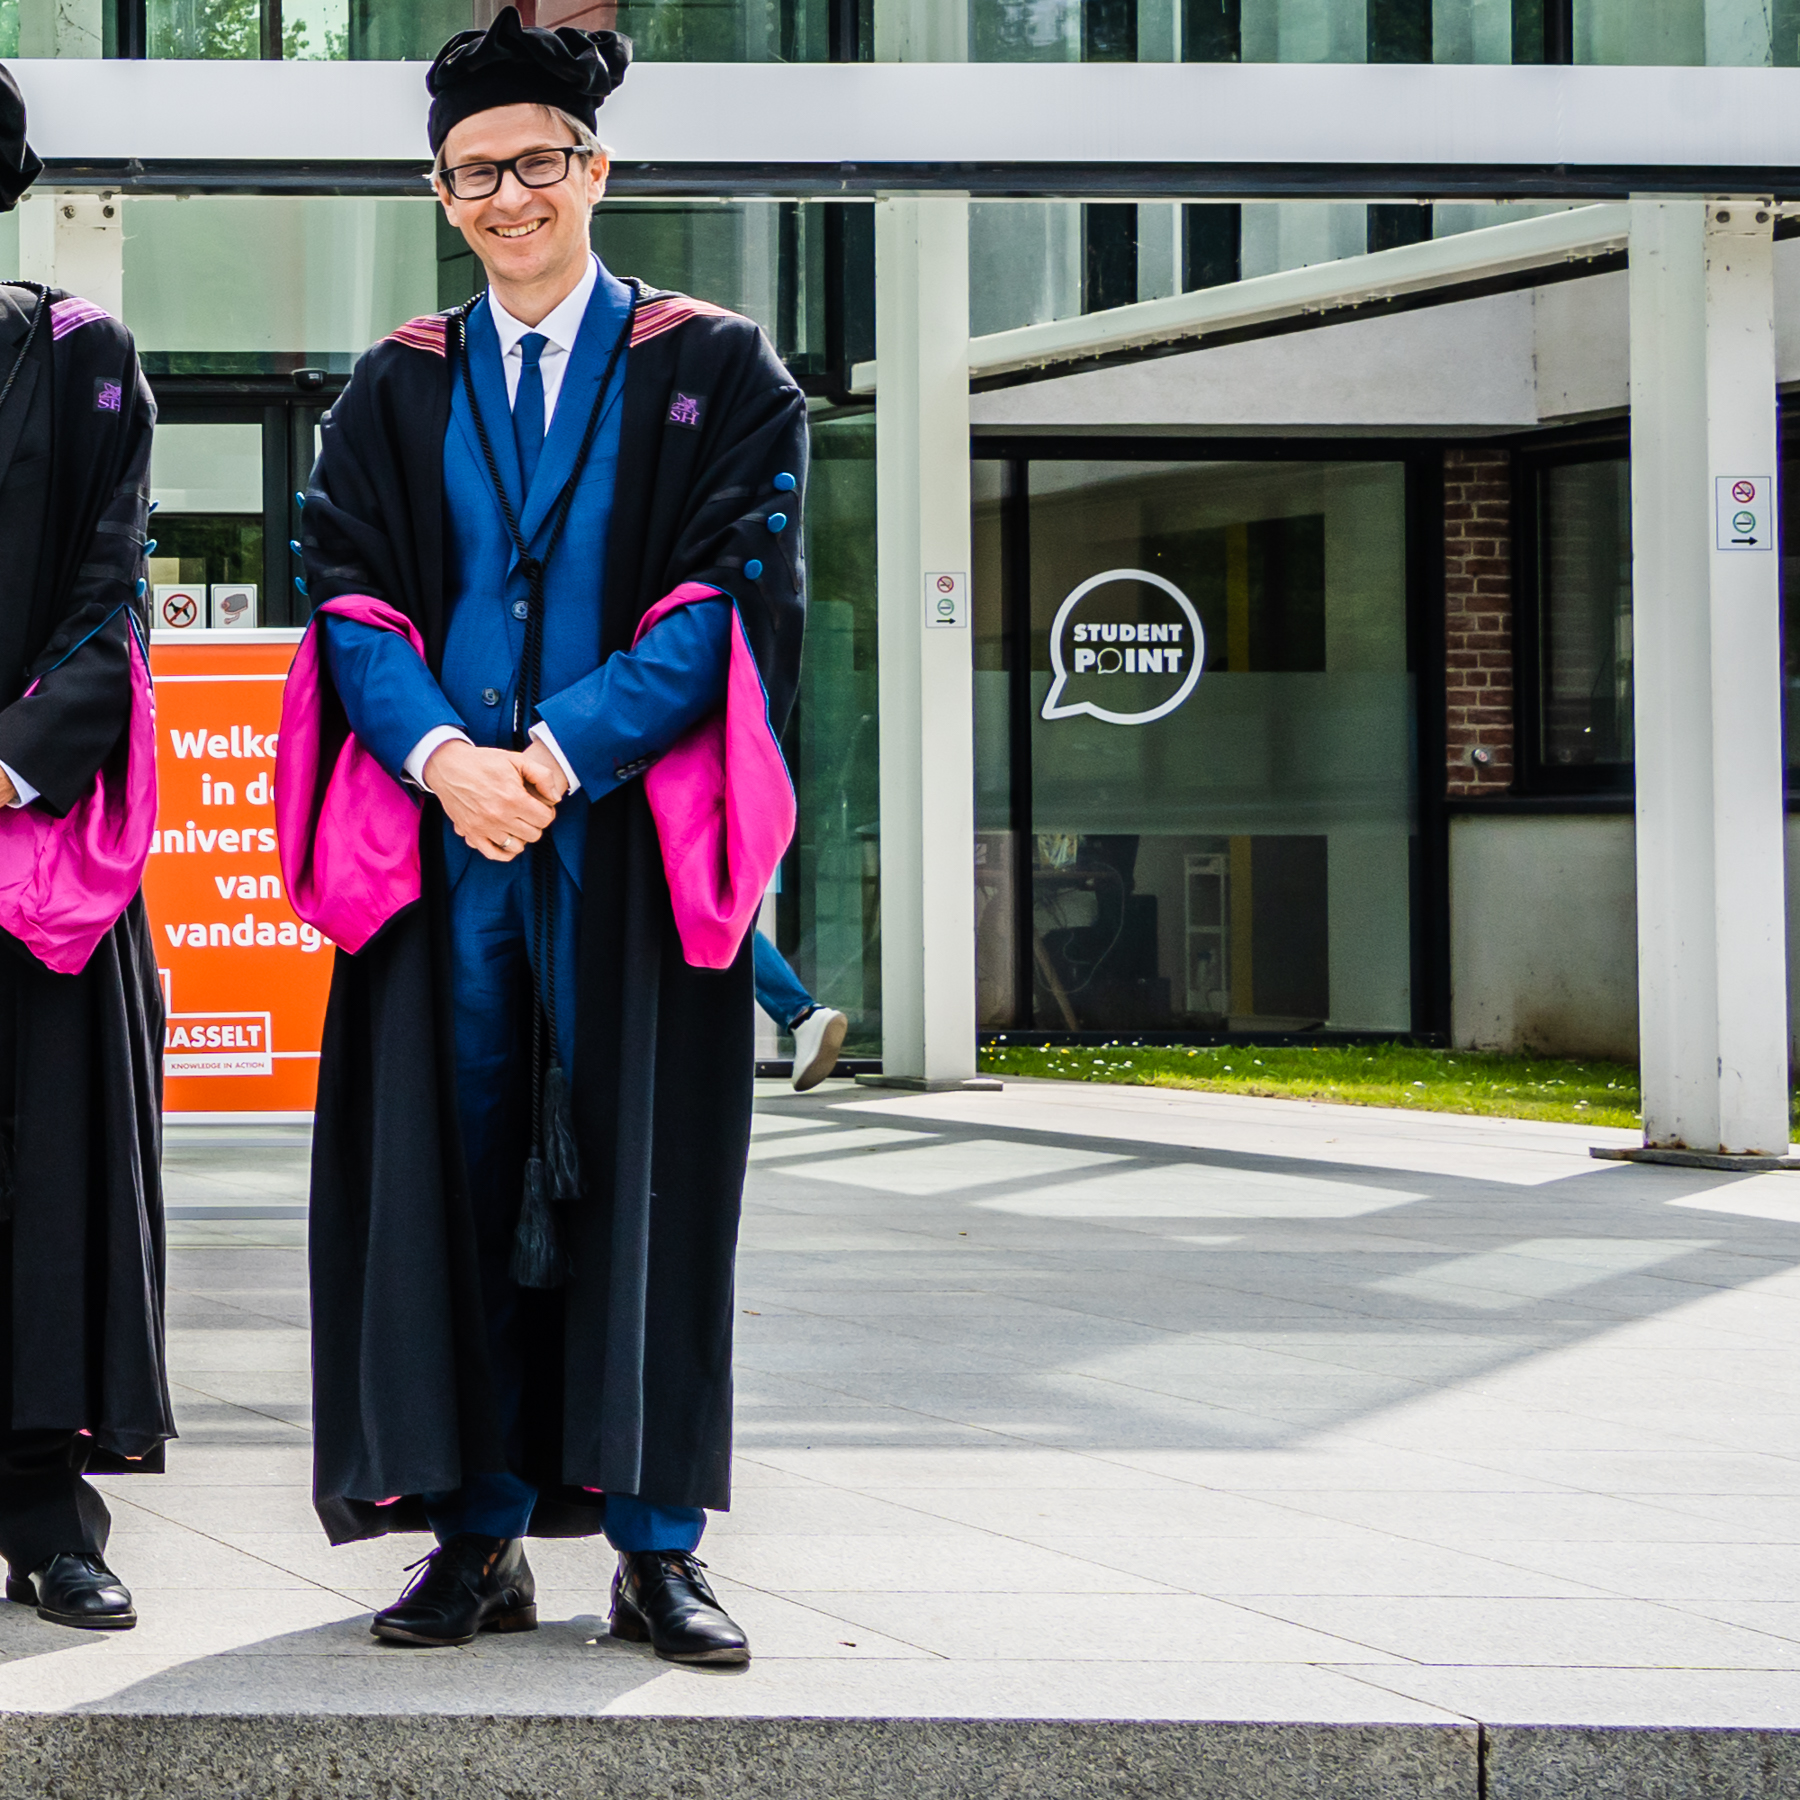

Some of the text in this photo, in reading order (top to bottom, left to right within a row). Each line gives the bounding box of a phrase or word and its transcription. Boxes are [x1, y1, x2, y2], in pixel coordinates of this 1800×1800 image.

[669, 410, 697, 425] SH
[1073, 623, 1183, 642] STUDENT
[1074, 647, 1183, 674] POINT
[202, 772, 275, 805] in d
[214, 875, 281, 899] van
[171, 1062, 221, 1070] KNOWLEDGE
